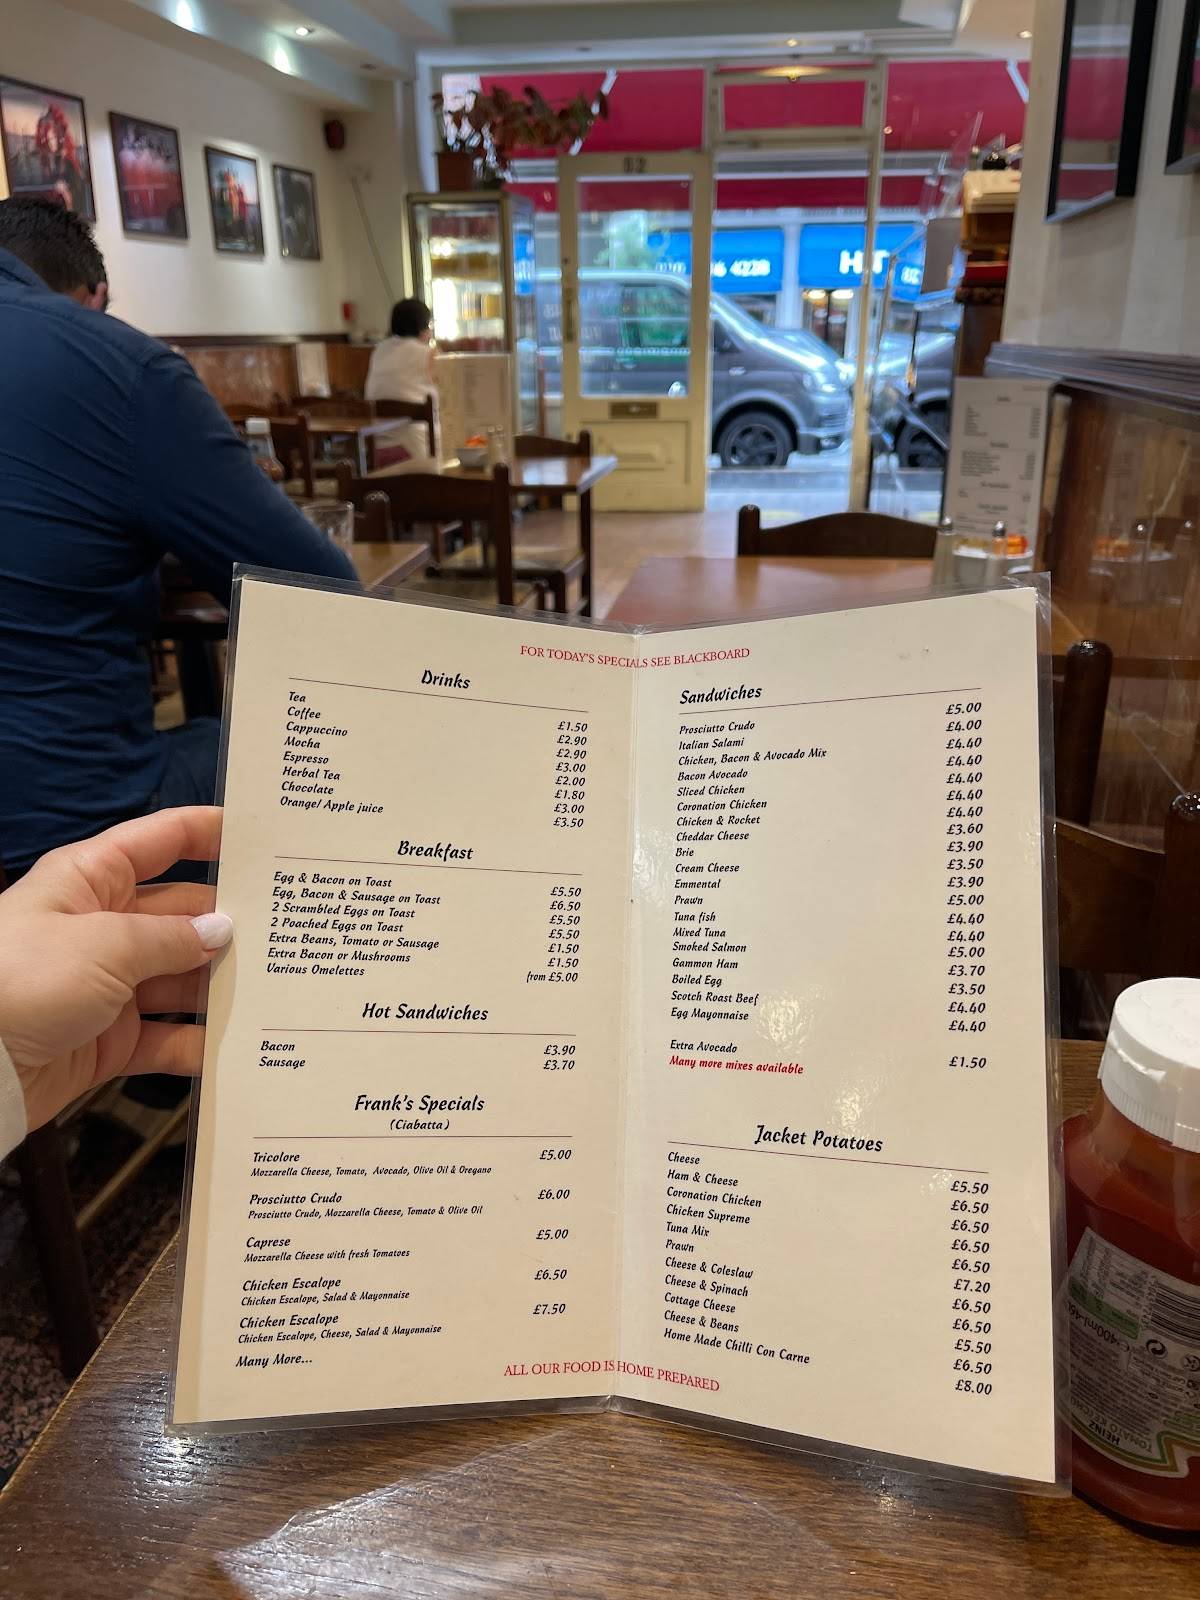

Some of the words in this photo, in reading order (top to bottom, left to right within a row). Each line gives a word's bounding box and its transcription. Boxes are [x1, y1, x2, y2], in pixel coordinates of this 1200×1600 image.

[520, 645, 545, 658] FOR
[546, 648, 595, 664] TODAY'S
[597, 654, 648, 669] SPECIALS
[650, 656, 671, 667] SEE
[673, 648, 750, 665] BLACKBOARD
[421, 669, 471, 689] Drinks
[289, 691, 306, 703] Tea
[679, 684, 762, 705] Sandwiches
[945, 702, 982, 715] £5.00
[286, 721, 348, 737] Cappuccino
[557, 721, 588, 732] £1.50
[679, 724, 725, 735] Prosciutto
[728, 720, 755, 731] Crudo
[678, 740, 709, 750] Italian
[711, 737, 745, 748] Salami
[678, 754, 717, 766] Chicken,
[720, 753, 750, 764] Bacon
[753, 751, 761, 762] &
[763, 748, 805, 761] Avocado
[807, 748, 827, 758] Mix
[946, 754, 983, 767] £4.40
[282, 766, 320, 779] Herbal
[323, 769, 340, 781] Tea
[555, 762, 586, 773] £3.00
[281, 780, 334, 795] Chocolate
[554, 789, 585, 800] £1.80
[676, 785, 706, 797] Sliced
[708, 784, 745, 795] Chicken
[280, 796, 322, 810] Orange/
[323, 799, 355, 813] Apple
[356, 802, 384, 814] juice
[946, 806, 983, 818] £4.40
[676, 816, 713, 827] Chicken
[716, 815, 724, 826] &
[727, 814, 761, 825] Rocket
[397, 840, 474, 862] Breakfast
[946, 840, 984, 853] £3.90
[674, 878, 721, 889] Emmental
[272, 886, 296, 900] Egg,
[300, 888, 334, 899] Bacon
[338, 889, 347, 900] &
[350, 890, 395, 905] Sausage
[415, 893, 441, 905] Toast
[550, 886, 582, 897] £5.50
[947, 894, 984, 906] £5.00
[272, 901, 280, 912] 2
[282, 902, 342, 915] Scrambled
[343, 905, 369, 918] Eggs
[372, 909, 385, 917] on
[389, 907, 416, 918] Toast
[674, 911, 695, 922] Tuna
[698, 911, 716, 924] fish
[548, 928, 580, 940] £5.50
[268, 932, 297, 943] Extra
[300, 933, 337, 947] Beans,
[342, 935, 379, 946] Tomato
[382, 939, 394, 947] or
[396, 937, 439, 951] Sausage
[672, 941, 710, 952] Smoked
[711, 941, 747, 952] Salmon
[947, 946, 985, 958] £5.00
[267, 962, 308, 974] Various
[311, 964, 365, 976] Omelettes
[547, 957, 579, 968] £1.50
[672, 957, 713, 968] Gammon
[716, 958, 738, 969] Ham
[526, 971, 546, 983] from
[548, 971, 578, 982] £5.00
[948, 983, 986, 995] £3.50
[671, 990, 702, 1001] Scotch
[705, 991, 732, 1003] Roast
[735, 993, 759, 1007] Beef
[362, 1002, 391, 1019] Hot
[395, 1003, 489, 1021] Sandwiches
[260, 1040, 295, 1051] Bacon
[259, 1056, 306, 1070] Sausage
[669, 1055, 697, 1069] Many
[699, 1060, 723, 1069] more
[725, 1060, 754, 1071] mixes
[756, 1062, 804, 1075] available
[949, 1056, 987, 1069] £1.50
[354, 1094, 414, 1111] Frank's
[418, 1094, 485, 1115] Specials
[390, 1118, 450, 1131] (Ciabatta)
[754, 1124, 807, 1145] Jacket
[812, 1130, 883, 1152] Potatoes
[253, 1151, 300, 1163] Tricolore
[539, 1149, 572, 1161] £5.00
[668, 1151, 700, 1165] Cheese
[250, 1167, 298, 1177] Mozzarella
[300, 1167, 332, 1178] Cheese,
[336, 1166, 367, 1176] Tomato,
[372, 1166, 410, 1176] Avocado,
[413, 1165, 434, 1174] Olive
[436, 1165, 449, 1174] Oil
[450, 1165, 456, 1174] &
[459, 1165, 492, 1176] Oregano
[249, 1193, 306, 1205] Prosciutto
[310, 1192, 342, 1204] Crudo
[667, 1186, 718, 1202] Coronation
[722, 1193, 762, 1207] Chicken
[666, 1221, 688, 1234] Tuna
[691, 1224, 710, 1237] Mix
[950, 1219, 989, 1234] £6.50
[246, 1236, 291, 1250] Caprese
[665, 1238, 694, 1253] Prawn
[244, 1251, 292, 1263] Mozzarella
[294, 1251, 324, 1261] Cheese
[327, 1249, 346, 1259] with
[348, 1248, 370, 1261] fresh
[373, 1249, 410, 1258] Tomatoes
[665, 1256, 697, 1271] Cheese
[699, 1261, 707, 1273] &
[711, 1263, 754, 1279] Coleslaw
[951, 1258, 990, 1274] £6.50
[534, 1269, 567, 1281] £6.50
[242, 1278, 288, 1292] Chicken
[292, 1276, 341, 1290] Escalope
[664, 1292, 700, 1309] Cottage
[703, 1298, 736, 1313] Cheese
[952, 1318, 991, 1334] £6.50
[238, 1333, 274, 1344] Chicken
[276, 1330, 317, 1342] Escalope,
[320, 1329, 352, 1339] Cheese,
[355, 1326, 381, 1337] Salad
[382, 1326, 389, 1335] &
[391, 1324, 442, 1337] Mayonnaise
[664, 1327, 691, 1342] Home
[693, 1333, 722, 1348] Made
[725, 1339, 753, 1354] Chilli
[756, 1344, 775, 1358] Con
[779, 1348, 810, 1364] Carne
[235, 1355, 269, 1369] Many
[272, 1353, 312, 1365] More...
[504, 1364, 529, 1376] ALL
[531, 1362, 561, 1375] OUR
[563, 1361, 602, 1374] FOOD
[603, 1360, 615, 1372] IS
[616, 1360, 654, 1379] HOME
[656, 1368, 720, 1392] PREPARED
[955, 1379, 992, 1395] £8.00
[1088, 1420, 1121, 1446] HEINZ
